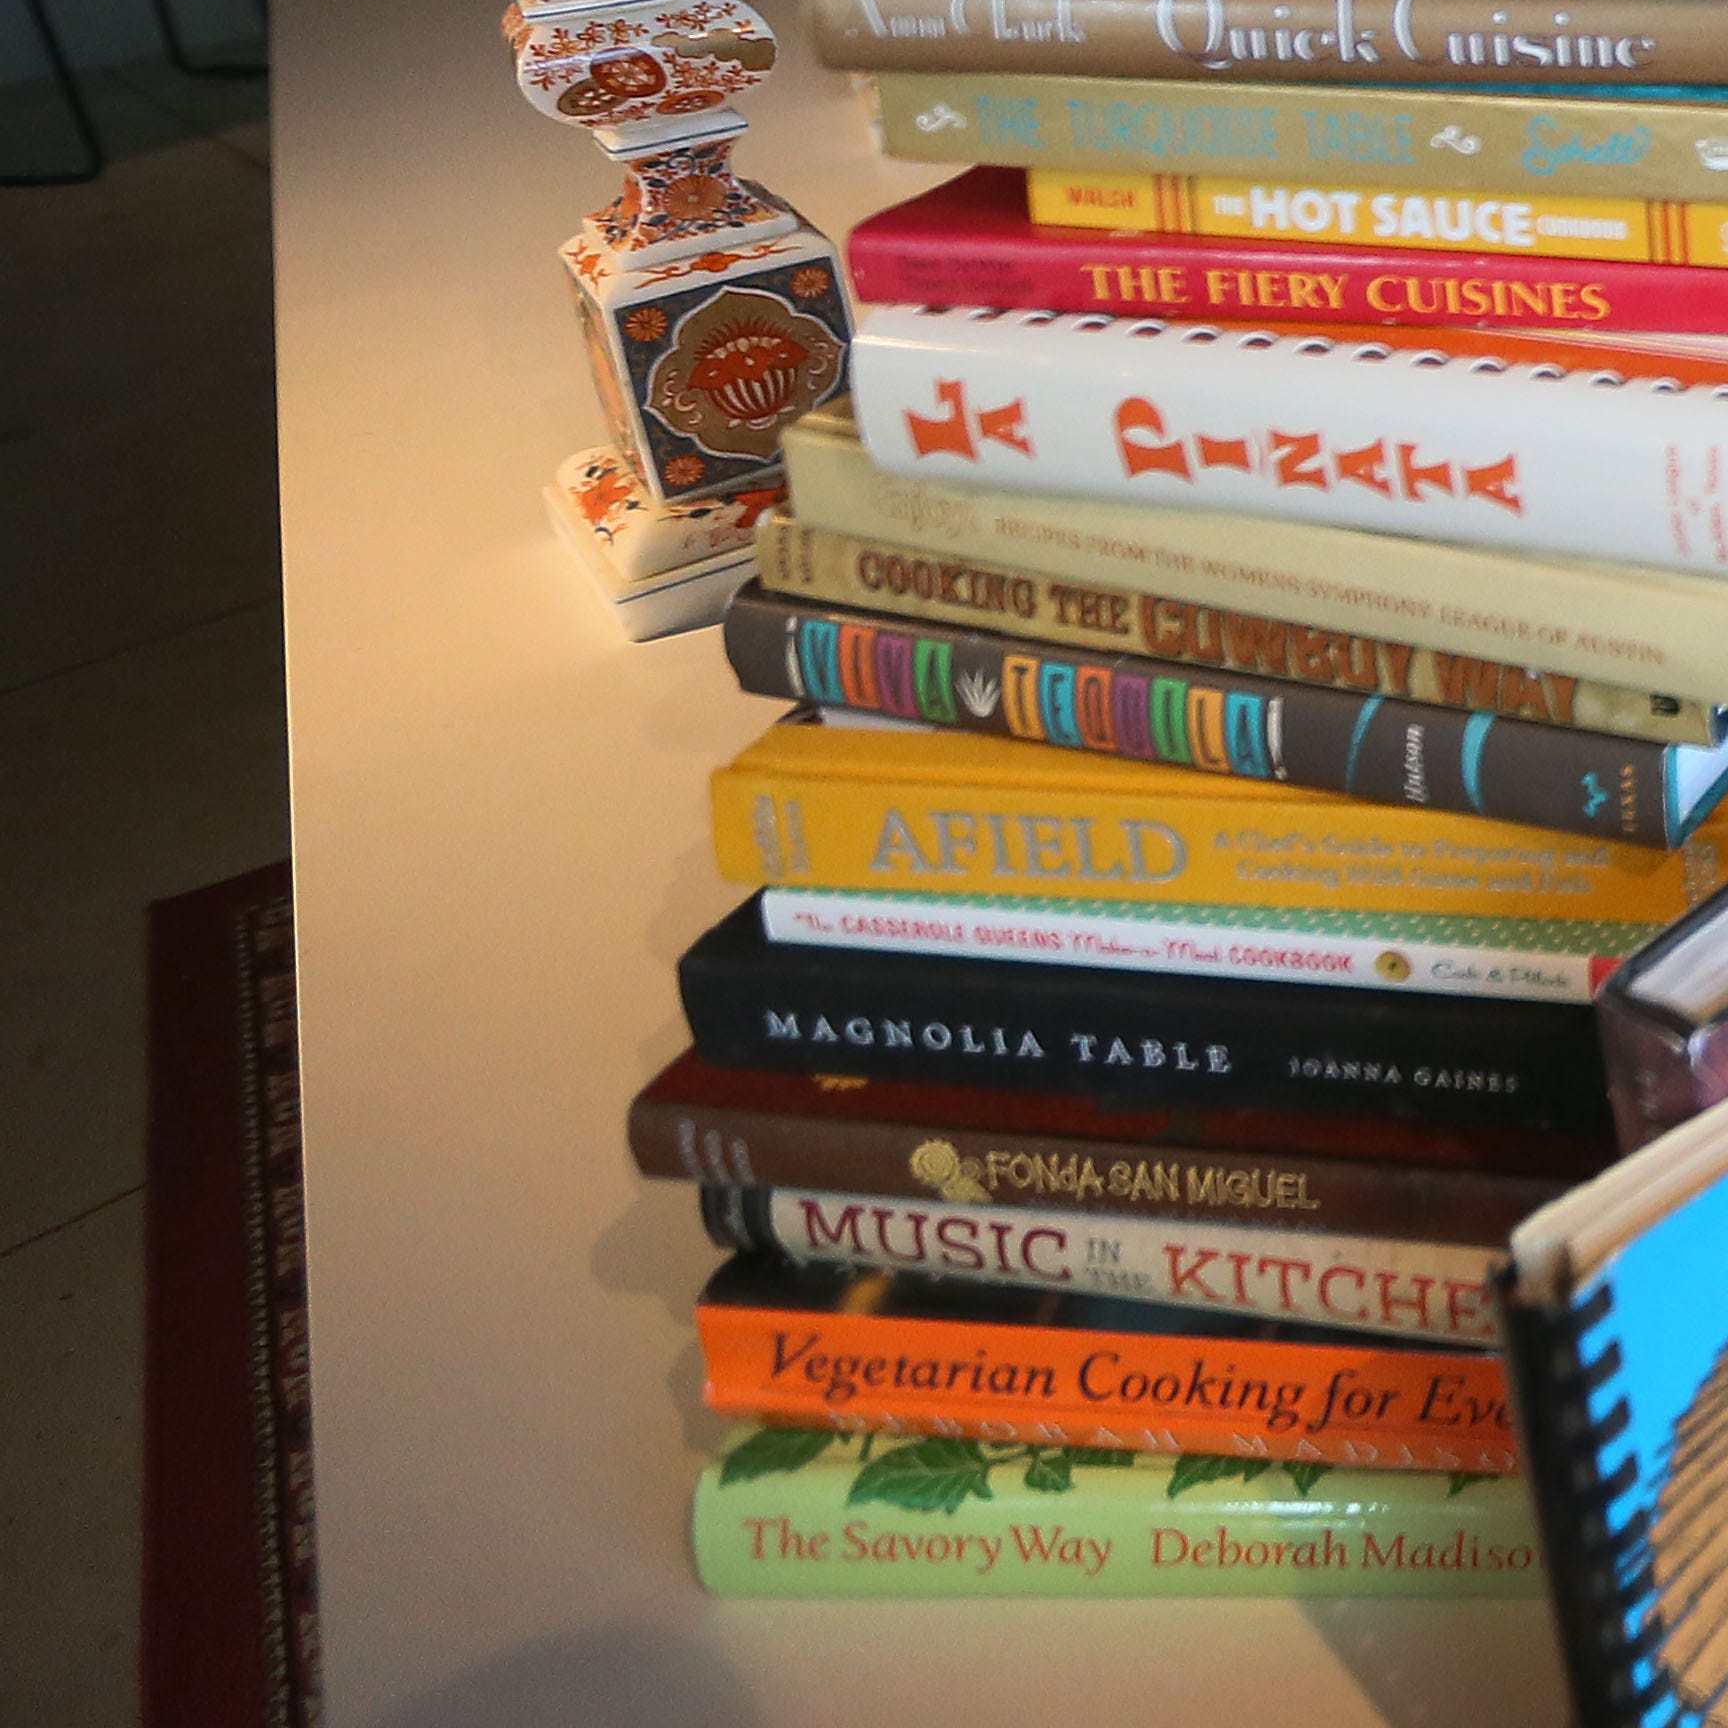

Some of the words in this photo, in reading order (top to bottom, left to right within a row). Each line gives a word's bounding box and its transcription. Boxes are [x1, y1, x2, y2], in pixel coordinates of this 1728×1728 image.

[976, 96, 1045, 147] THE
[1066, 100, 1279, 158] TURQUOISE
[1303, 111, 1416, 164] TABLE
[1066, 184, 1135, 209] WALSH
[1249, 187, 1362, 232] HOT
[1372, 191, 1533, 246] SAUCE
[1081, 262, 1192, 305] THE
[1207, 269, 1346, 310] FIERY
[1365, 272, 1611, 320] CUISINES
[902, 376, 1037, 462] LA
[857, 551, 1036, 617] COOKING
[1051, 582, 1128, 634] THE
[1404, 725, 1429, 804] Hutson
[869, 809, 1188, 885] AFIELD
[840, 916, 964, 944] CASSEROLE
[974, 925, 1062, 952] QUEENS
[1229, 945, 1355, 974] COOKBOOK
[763, 1007, 1046, 1059] MAGNOLIA
[1069, 1031, 1232, 1076] TABLE
[1287, 1054, 1401, 1085] JOANNA
[1413, 1066, 1521, 1094] GAINES
[1108, 1160, 1180, 1202] SAN
[1185, 1164, 1320, 1211] MIGUEL
[800, 1198, 1073, 1283] MUSIC
[1086, 1236, 1122, 1264] IN
[769, 1331, 1055, 1403] Vegetarian
[1078, 1351, 1306, 1433] Cooking
[1306, 1367, 1400, 1432] for
[741, 1516, 831, 1562] The
[841, 1521, 1000, 1574] Savory
[1010, 1525, 1113, 1576] Way
[1150, 1525, 1349, 1570] Deborah
[1362, 1529, 1540, 1570] Madiso
